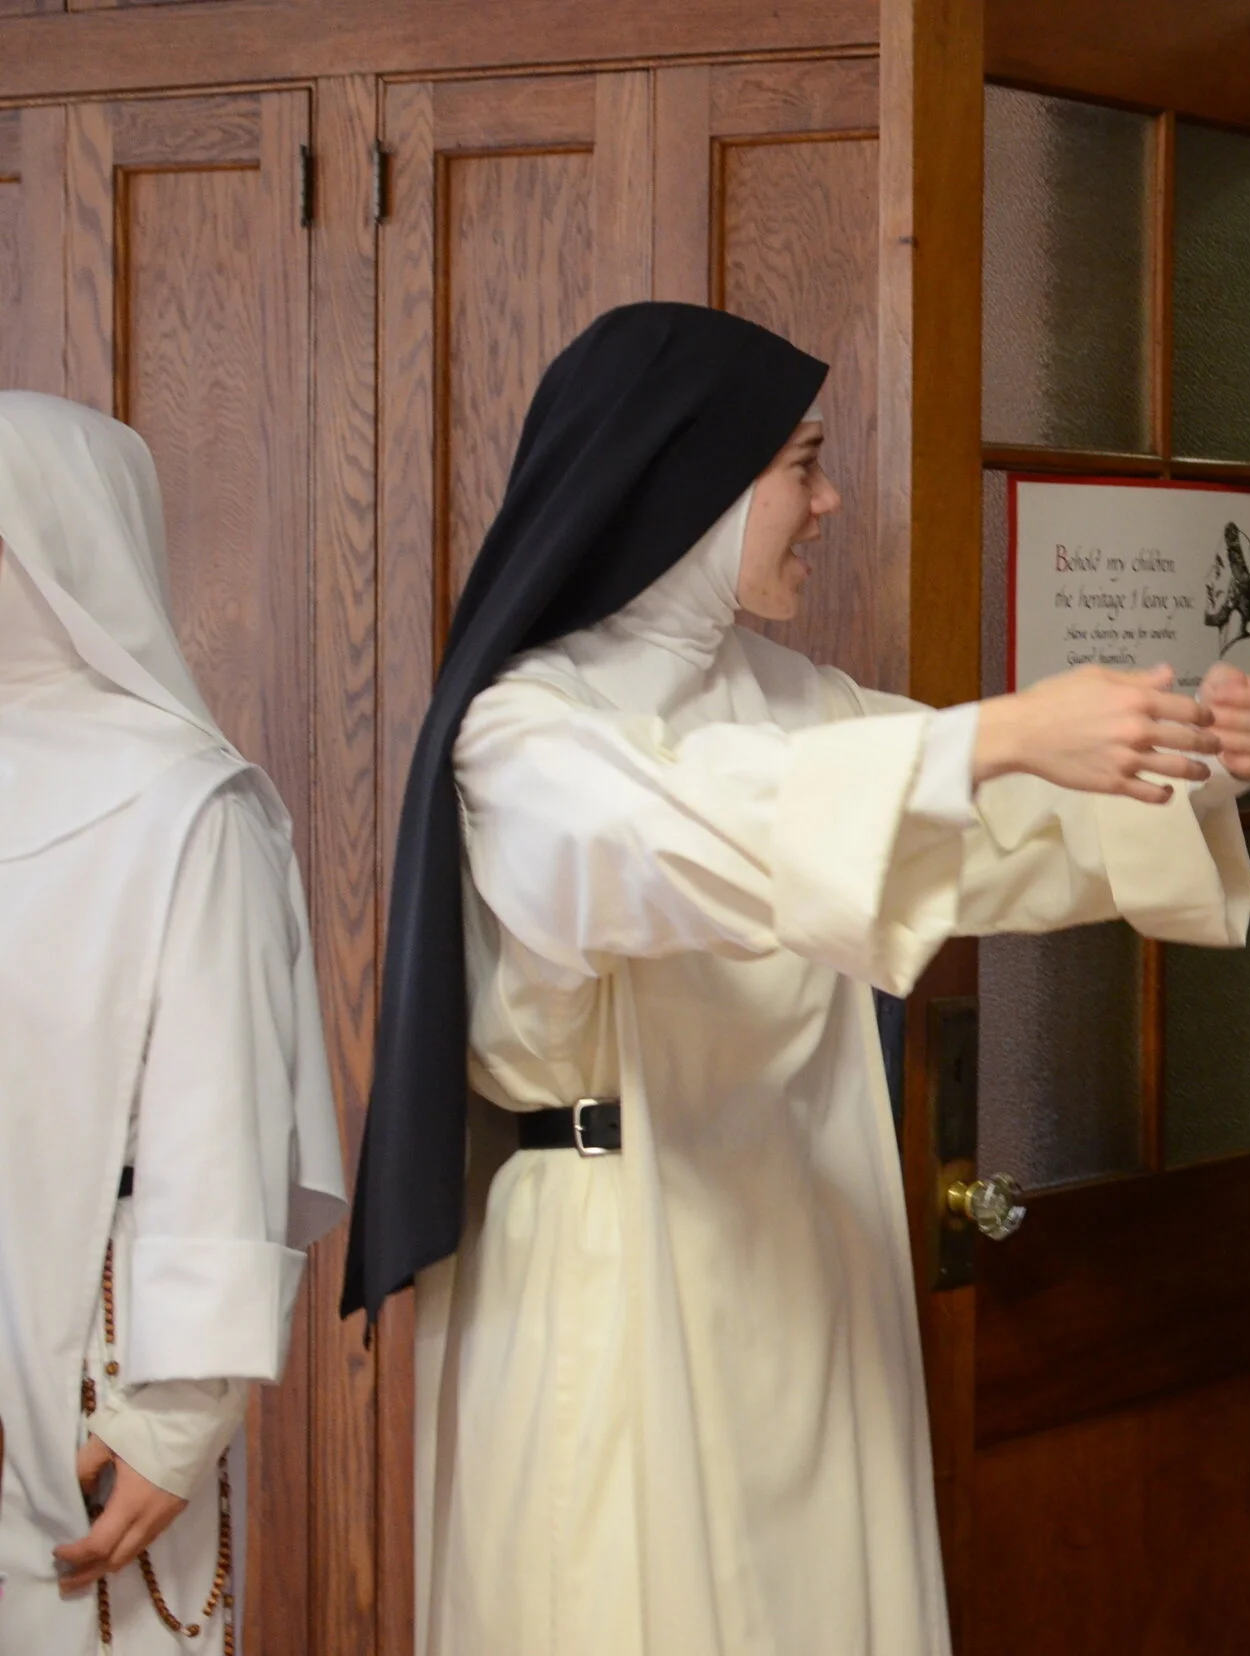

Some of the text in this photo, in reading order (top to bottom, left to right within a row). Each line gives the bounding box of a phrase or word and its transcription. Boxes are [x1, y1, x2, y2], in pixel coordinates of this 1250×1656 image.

[1056, 544, 1175, 582] Behold my children
[1054, 584, 1073, 609] the
[1079, 585, 1126, 620] heritage
[1140, 585, 1168, 609] leave
